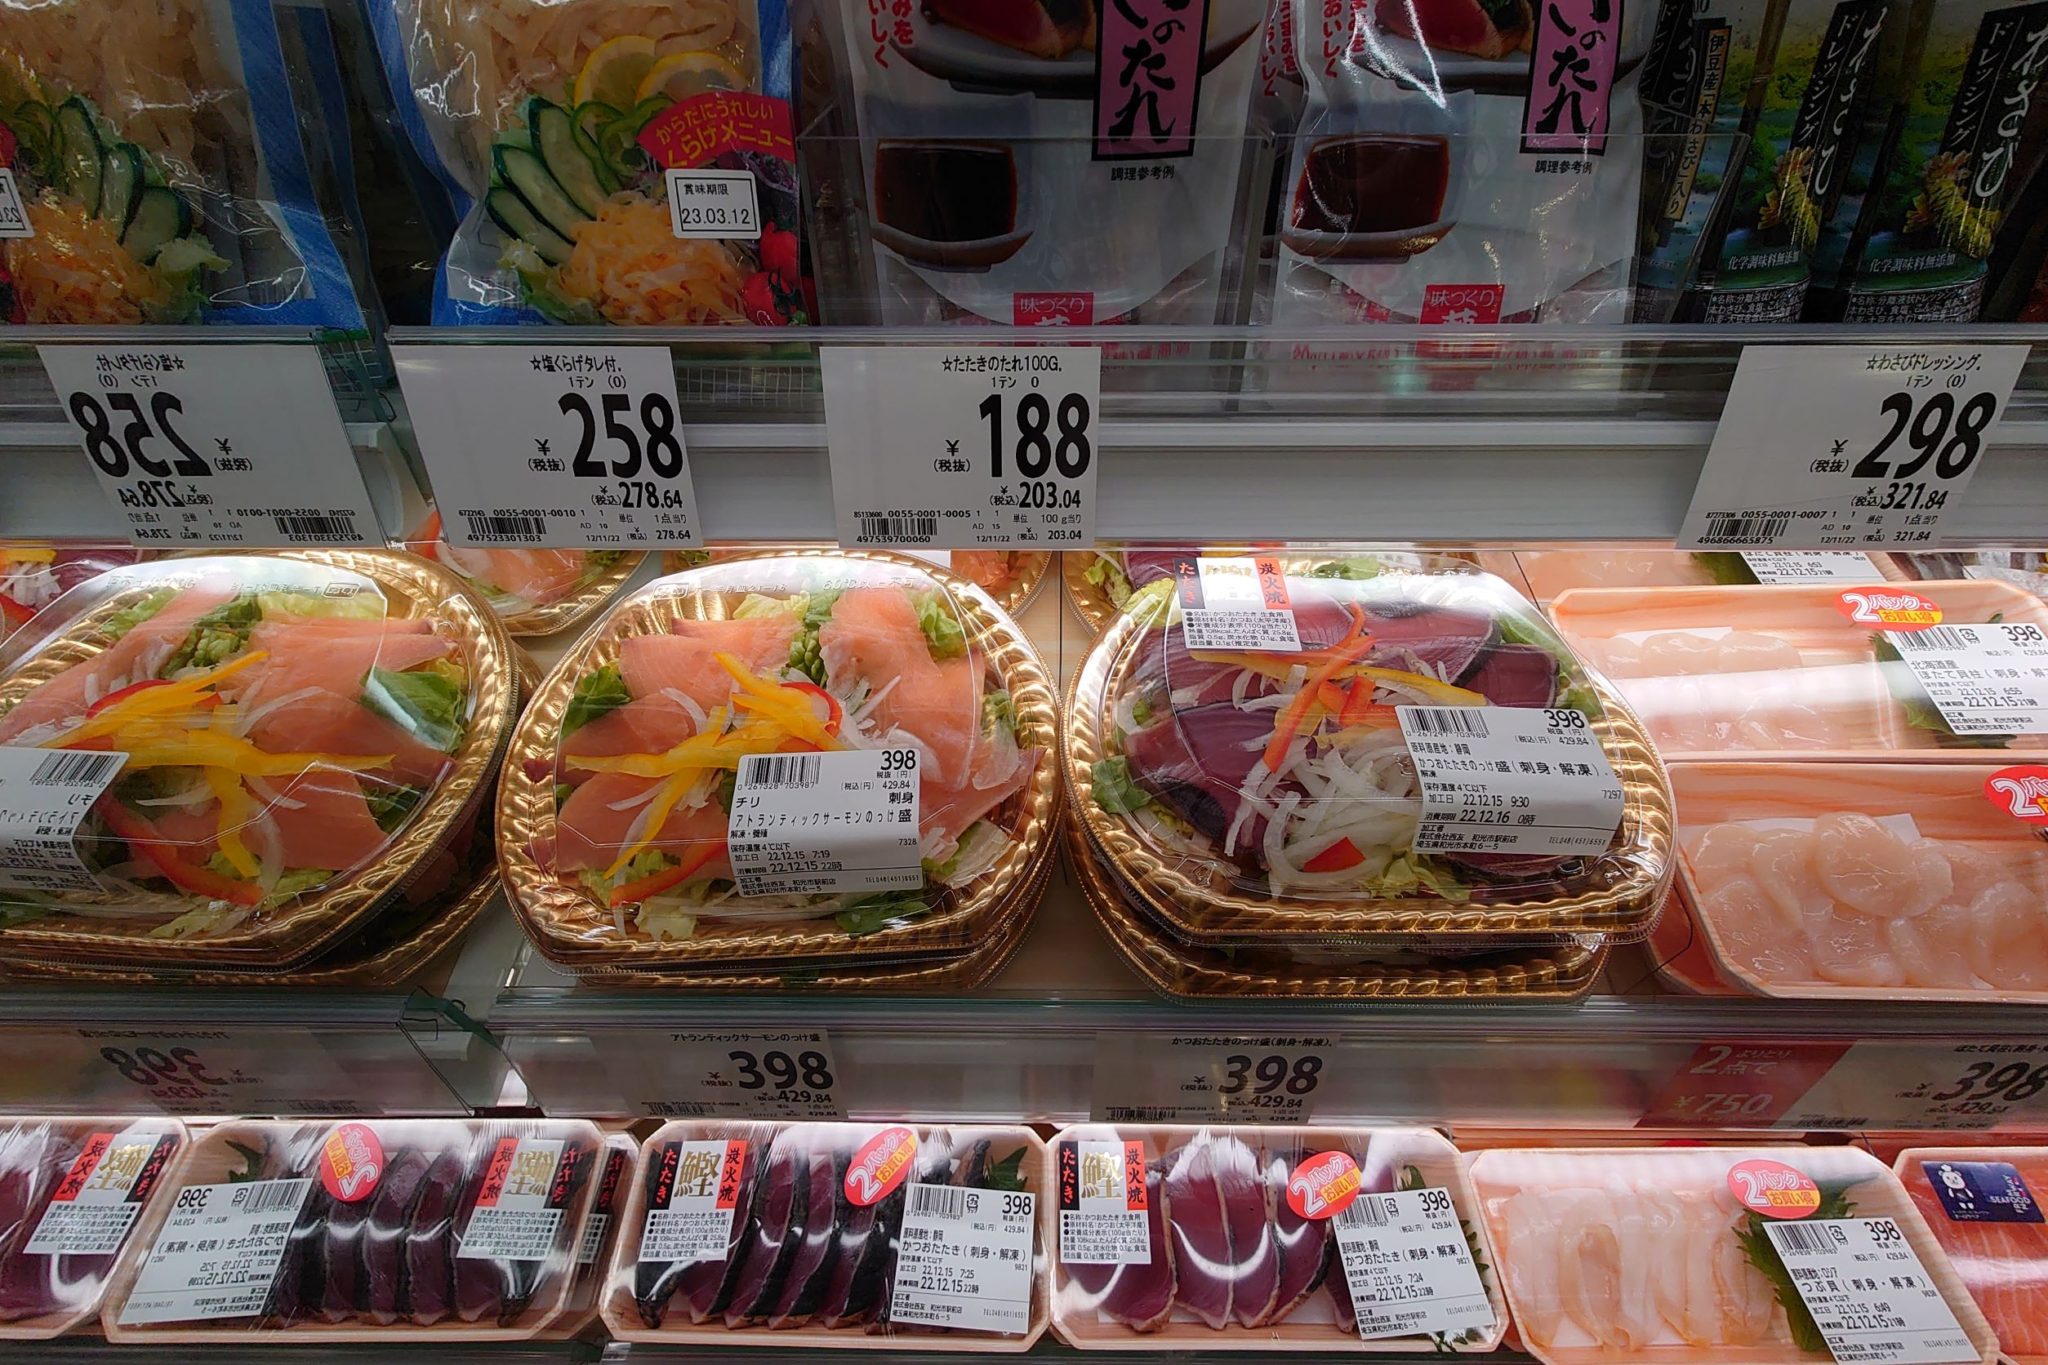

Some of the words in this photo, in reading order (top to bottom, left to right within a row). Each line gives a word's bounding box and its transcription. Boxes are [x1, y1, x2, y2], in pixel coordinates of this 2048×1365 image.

[1799, 15, 1859, 142] ドレッシング
[1951, 22, 2014, 146] ドレッシング
[656, 98, 774, 145] からだにうれしい
[667, 120, 792, 168] くらげメニュー
[1111, 166, 1175, 181] 調理参考例
[683, 183, 729, 196] 賞味期限
[682, 208, 750, 224] 23.03.12
[1020, 297, 1085, 314] 味づくり
[1431, 289, 1495, 307] 味づくり
[541, 355, 622, 372] 塩くらげタレ付.
[953, 355, 1063, 372] たたきのたれ100G.
[1878, 353, 1982, 371] わさびドレッシング.
[568, 377, 594, 388] 1テン
[991, 377, 1017, 388] 1テン
[1906, 376, 1933, 387] 1テン
[558, 392, 683, 478] 258
[979, 392, 1091, 479] 188
[1850, 392, 1997, 480] 298
[535, 439, 550, 455] ¥
[945, 440, 960, 456] ¥
[1830, 439, 1849, 457] ¥
[528, 458, 566, 472] (税抜)
[933, 459, 971, 473] (税抜)
[1809, 459, 1849, 474] (税抜)
[591, 494, 621, 506] (税込)
[618, 482, 682, 508] 278.64
[989, 495, 1019, 506] (税込)
[1019, 481, 1081, 509] 203.04
[1850, 495, 1884, 507] (税込)
[1880, 483, 1949, 510] 321.84
[888, 510, 971, 518] 0055-0001-0005
[1741, 511, 1828, 519] 0055-0001-0007
[467, 534, 542, 542] 497523301303
[656, 530, 691, 540] 278.64
[856, 535, 931, 543] 497539700060
[1047, 530, 1082, 540] 203.04
[1893, 531, 1931, 542] 321.84
[1179, 562, 1196, 604] たたき
[1259, 563, 1286, 604] 炭火焼
[2001, 625, 2043, 641] 398
[1544, 710, 1585, 728] 398
[880, 750, 916, 770] 398
[1421, 769, 1438, 778] 解凍
[888, 792, 913, 804] 刺身
[1428, 794, 1454, 804] 加工日
[1463, 794, 1503, 807] 22.12.15
[1510, 795, 1530, 808] 9:30
[1602, 789, 1622, 799] 7297
[736, 797, 760, 808] チリ
[735, 809, 912, 828] アトランティックサーモンのっけ盛
[1424, 812, 1457, 821] 消費期限
[1459, 810, 1511, 824] 22.12.16
[898, 838, 917, 846] 7328
[735, 853, 759, 862] 加工日
[767, 851, 806, 861] 22.12.15
[812, 850, 831, 859] 7:19
[770, 861, 818, 873] 22.12.15
[821, 861, 842, 871] 22時
[670, 1033, 821, 1042] アトランティックサーモンのっけ盛
[728, 1051, 834, 1090] 398
[1218, 1055, 1323, 1094] 398
[1931, 1061, 2048, 1101] 398
[778, 1090, 832, 1103] 429.84
[1250, 1095, 1303, 1109] 429.84
[1695, 1093, 1774, 1114] 750
[656, 1149, 677, 1203] たたき
[674, 1150, 722, 1198] 鰹
[718, 1148, 740, 1201] 炭火焼
[1063, 1148, 1076, 1205] たたき
[1081, 1152, 1124, 1199] 鰹
[1126, 1148, 1144, 1204] 炭火焼
[1002, 1195, 1032, 1215] 398
[1418, 1190, 1450, 1212] 398
[1864, 1221, 1901, 1242] 398
[922, 1265, 953, 1277] 22.12.15
[960, 1269, 975, 1278] 7:25
[921, 1276, 963, 1292] 22.12.15
[1376, 1286, 1418, 1301] 22.12.15
[1841, 1314, 1889, 1330] 22.12.15
